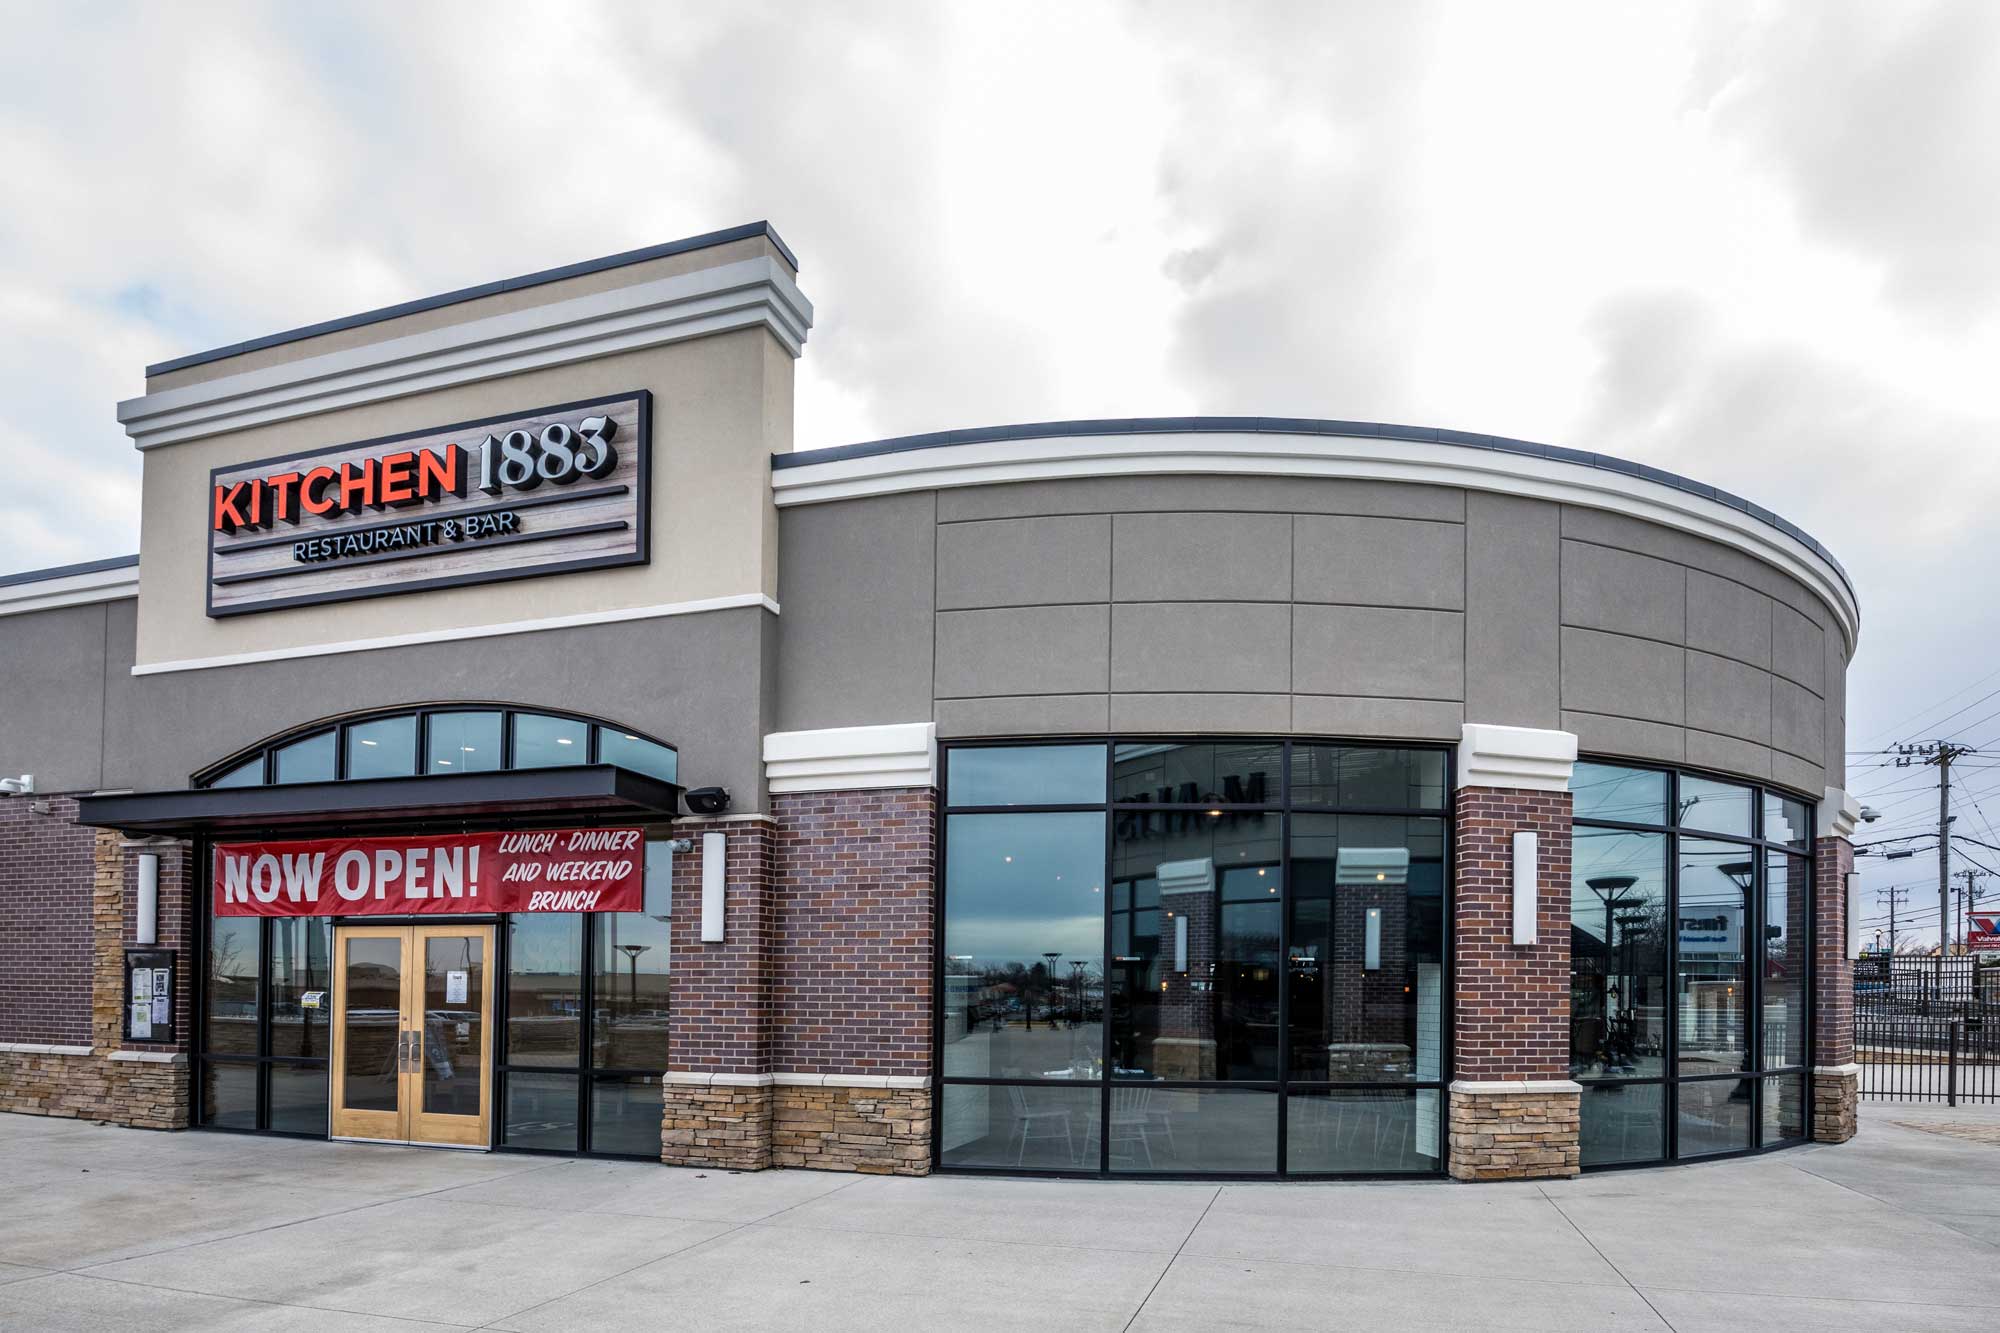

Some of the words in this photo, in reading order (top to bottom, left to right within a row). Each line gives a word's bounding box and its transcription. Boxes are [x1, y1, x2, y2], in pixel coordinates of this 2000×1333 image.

[214, 443, 460, 531] KITCHEN
[478, 415, 614, 491] 1883
[293, 525, 437, 561] RESTAURANT
[443, 519, 458, 538] &
[466, 511, 517, 535] BAR
[498, 831, 556, 853] LUNCH
[567, 830, 641, 853] DINNER
[224, 851, 325, 903] NOW
[334, 845, 481, 900] OPEN!
[502, 862, 538, 882] AND
[545, 859, 633, 882] WEEKEND
[527, 888, 601, 911] BRUNCH
